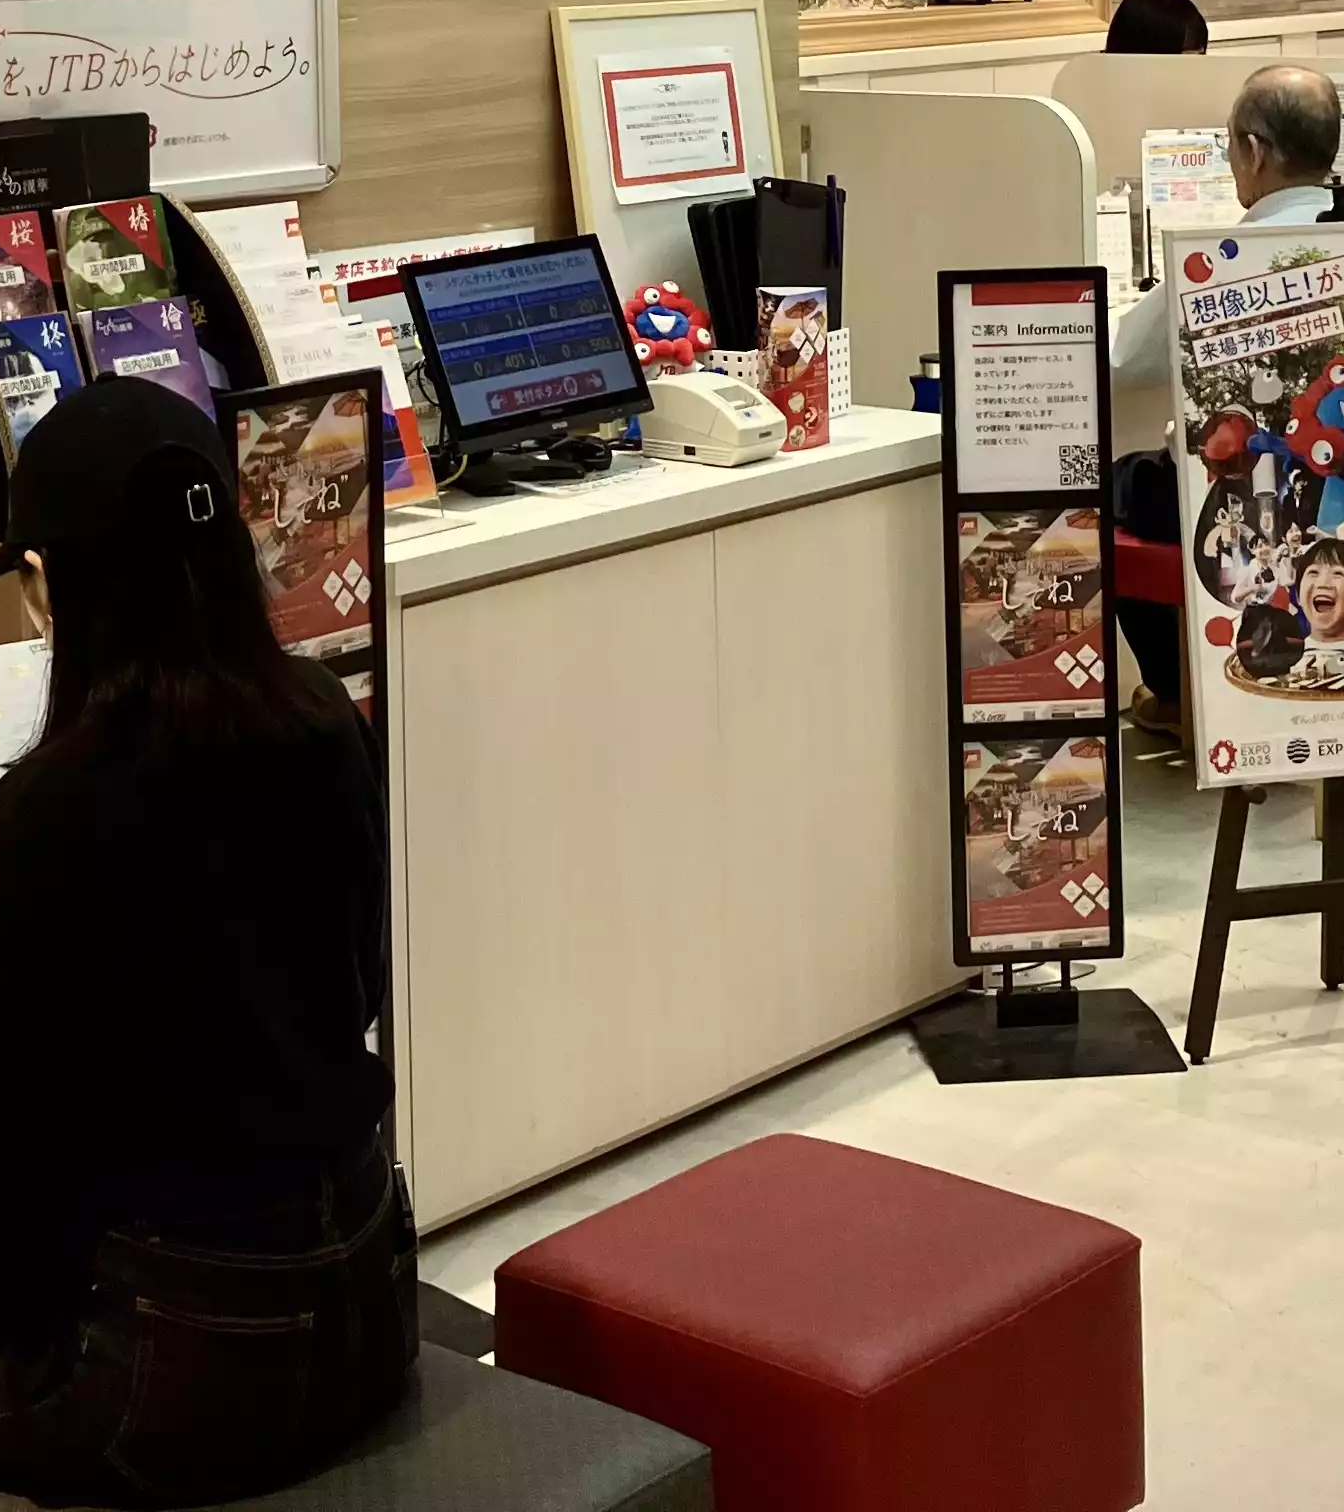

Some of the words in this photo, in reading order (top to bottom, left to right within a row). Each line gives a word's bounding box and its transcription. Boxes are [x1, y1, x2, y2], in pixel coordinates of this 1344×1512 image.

[9, 218, 36, 248] 桜
[89, 258, 140, 277] 店内閲覧用
[971, 323, 1009, 337] ご案内
[1016, 321, 1095, 336] Information
[1199, 311, 1341, 363] 来場予約受付中!
[121, 351, 174, 374] 店内閲覧用
[0, 375, 53, 396] 店内閲覧用
[1240, 744, 1272, 757] EXPO
[1241, 755, 1272, 767] 2025
